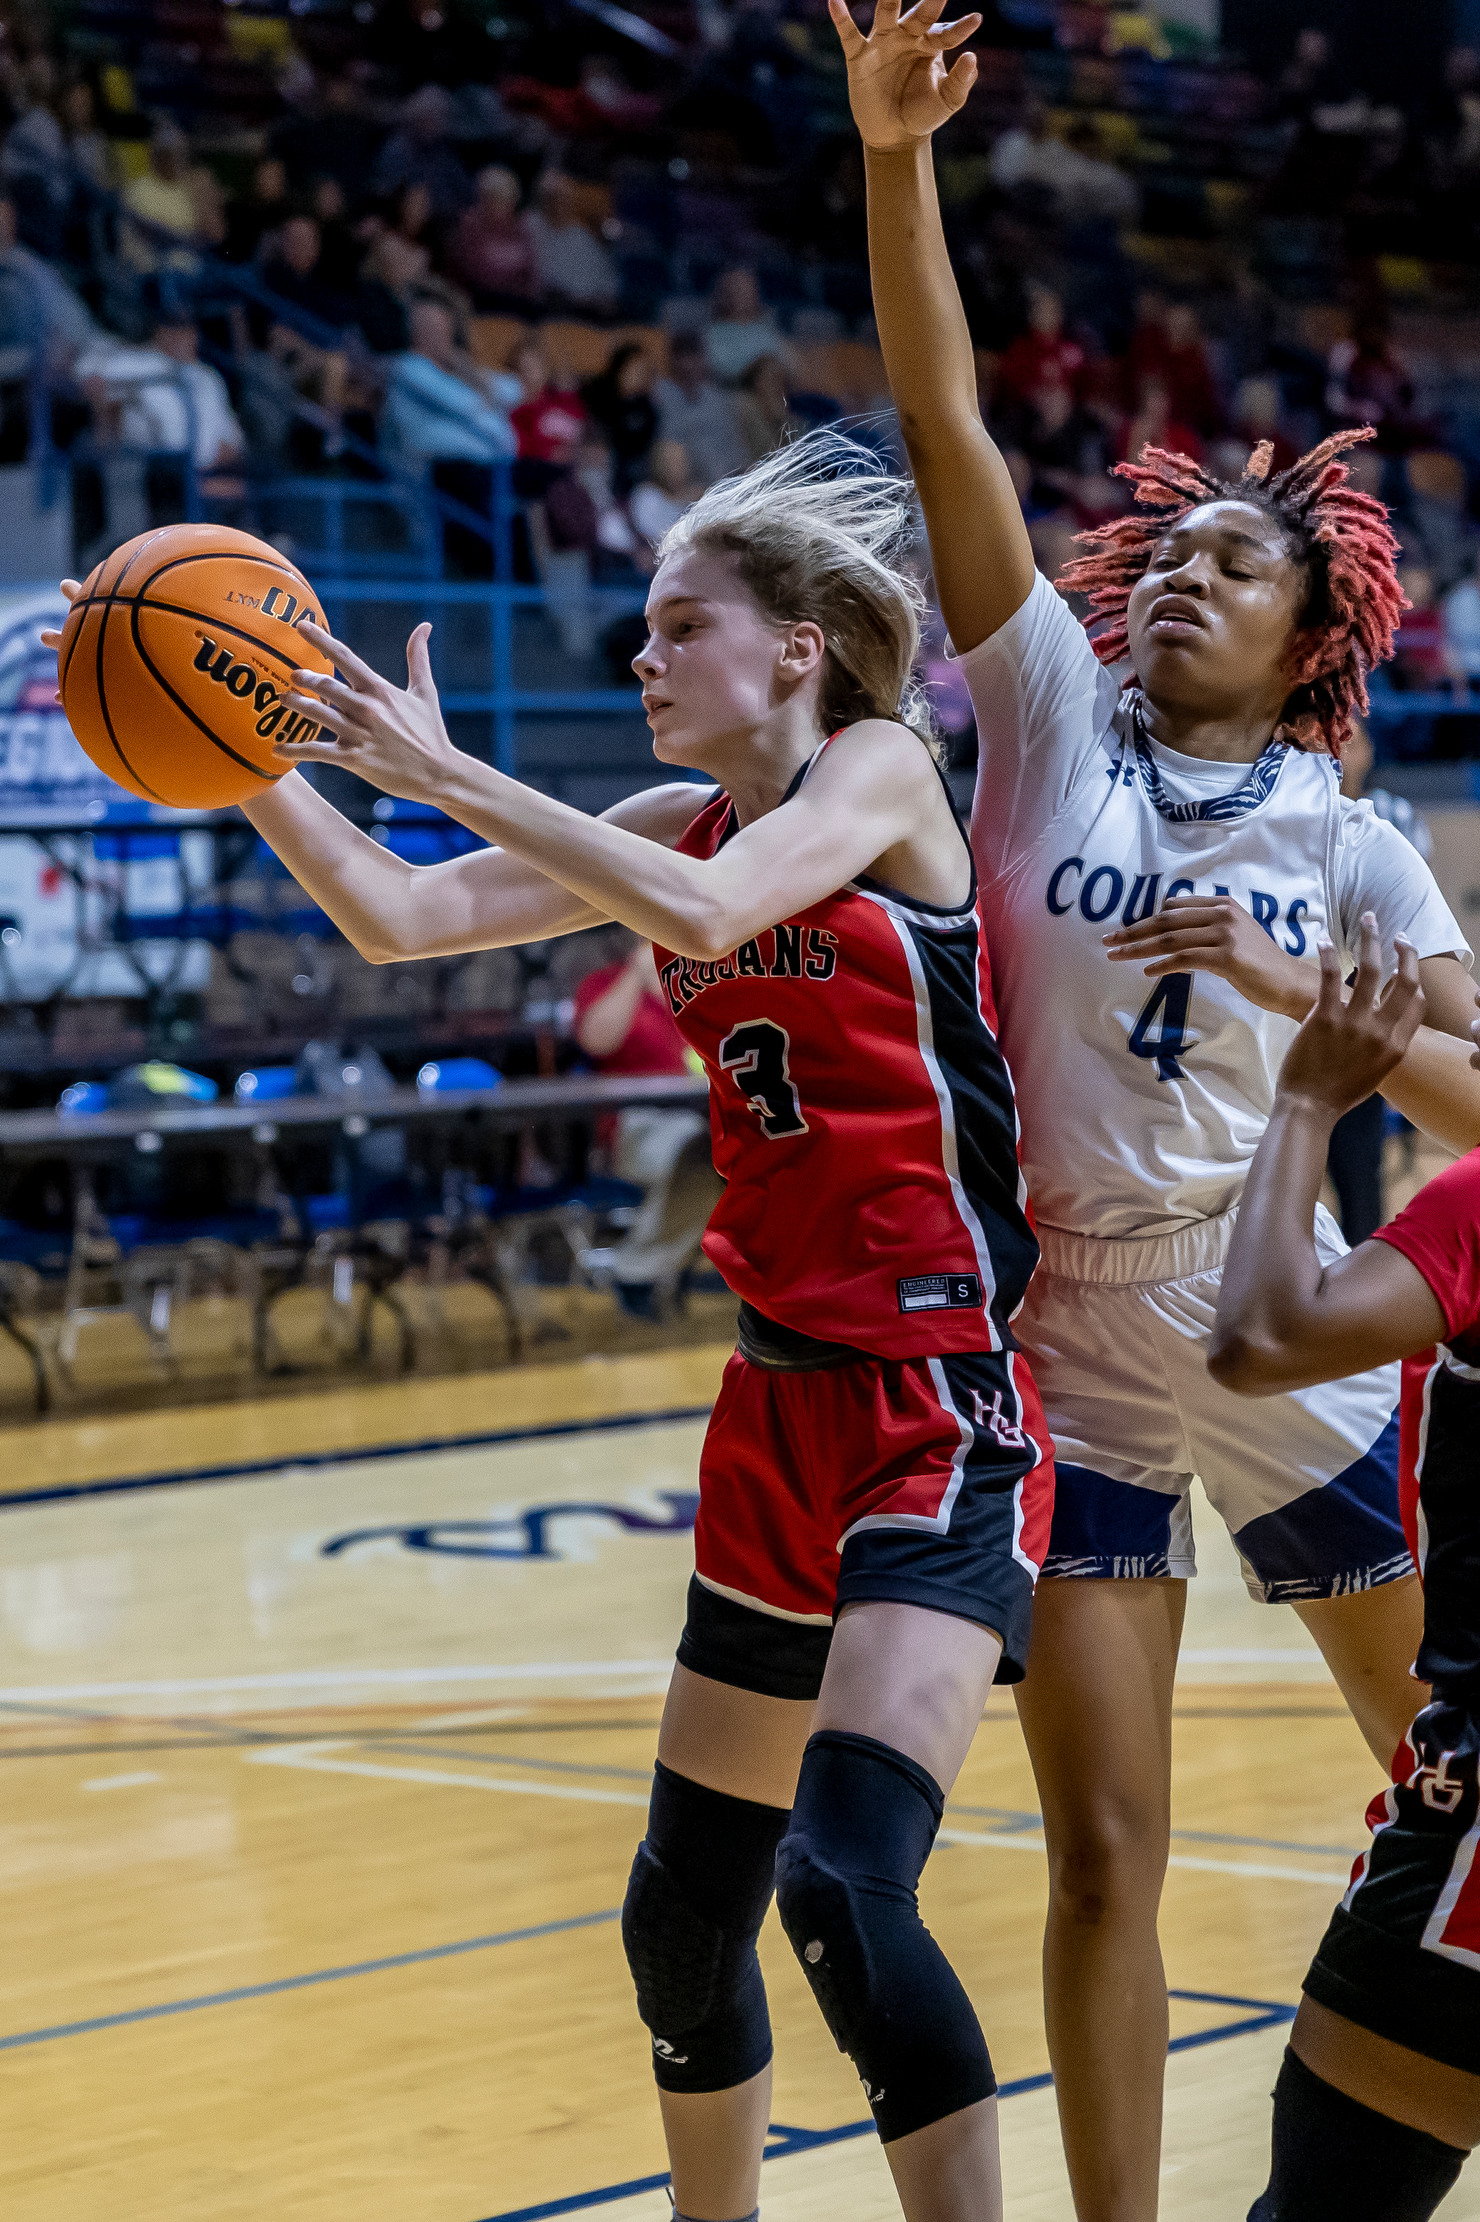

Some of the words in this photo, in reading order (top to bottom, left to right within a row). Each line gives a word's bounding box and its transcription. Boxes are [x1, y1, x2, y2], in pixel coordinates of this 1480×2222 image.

[1045, 855, 1308, 957] COURS
[719, 1017, 810, 1141] 3
[1127, 970, 1199, 1083] 4
[957, 1283, 969, 1298] S
